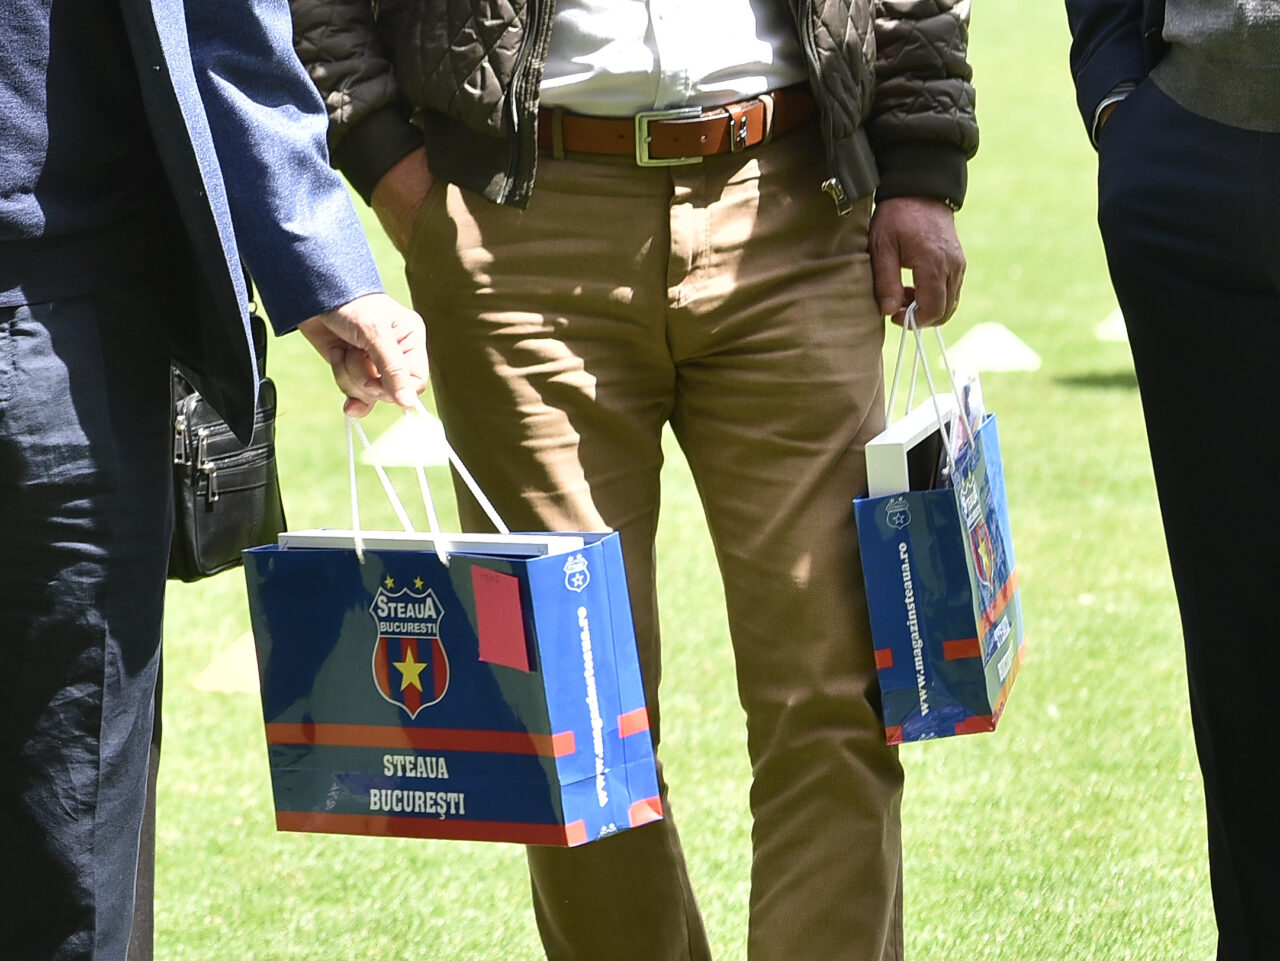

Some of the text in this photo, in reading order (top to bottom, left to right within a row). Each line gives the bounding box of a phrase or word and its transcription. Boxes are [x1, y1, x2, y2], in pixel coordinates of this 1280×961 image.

[377, 595, 437, 619] STEAUA
[380, 622, 436, 633] BUCURESTI
[898, 542, 930, 716] www.magazinsteaua.ro
[383, 754, 449, 779] STEAUA
